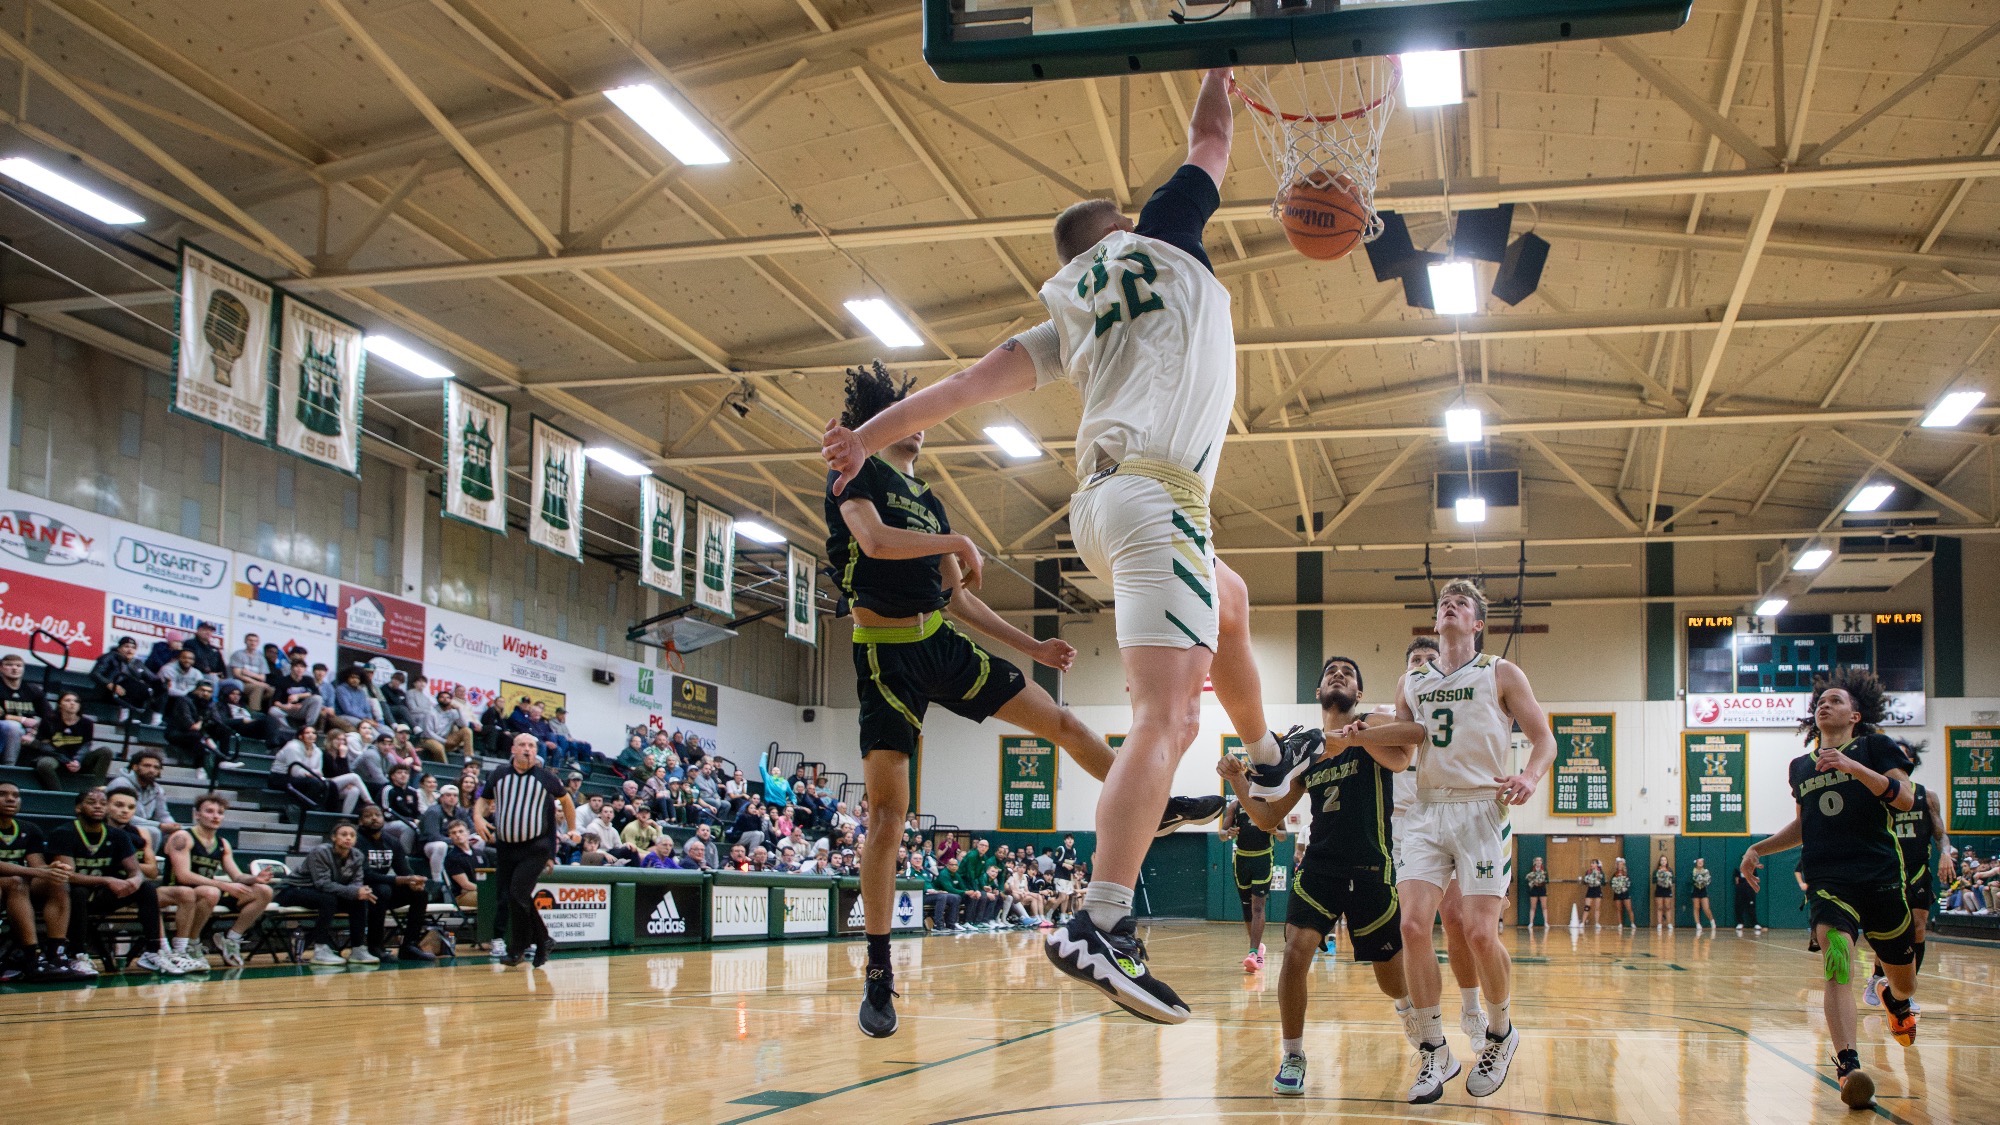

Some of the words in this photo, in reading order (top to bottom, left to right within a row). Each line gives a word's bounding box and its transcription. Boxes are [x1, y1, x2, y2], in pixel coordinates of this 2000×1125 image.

[1077, 251, 1164, 338] 22
[301, 435, 337, 461] 1990
[658, 526, 669, 543] 12
[132, 542, 211, 577] DYSART'S
[246, 564, 327, 606] CARON
[112, 598, 176, 626] CENTRAL
[453, 633, 499, 658] Creative
[1837, 634, 1865, 643] GUEST
[503, 634, 548, 660] Wight's
[1418, 687, 1475, 705] HUSSON
[1724, 698, 1762, 709] SACO
[1766, 697, 1794, 708] BAY
[1432, 708, 1453, 747] 3
[1557, 775, 1579, 784] 2004
[1587, 775, 1607, 784] 2010
[1559, 784, 1577, 793] 2011
[1955, 791, 1978, 799] 2009
[1004, 793, 1024, 801] 2009
[1033, 793, 1050, 801] 2011
[1322, 785, 1341, 813] 2
[1558, 792, 1577, 801] 2017
[1690, 794, 1712, 803] 2003
[1818, 790, 1844, 817] 0
[1957, 799, 1976, 807] 2011
[1005, 801, 1023, 809] 2021
[1031, 801, 1051, 809] 2022
[1557, 801, 1578, 809] 2019
[1587, 800, 1609, 809] 2020
[1690, 803, 1711, 812] 2007
[1956, 807, 1977, 816] 2015
[559, 888, 607, 902] DORR'S
[715, 895, 767, 924] HUSSON
[794, 896, 827, 923] EAGLES
[896, 905, 914, 918] NAC
[647, 916, 686, 934] adidas
